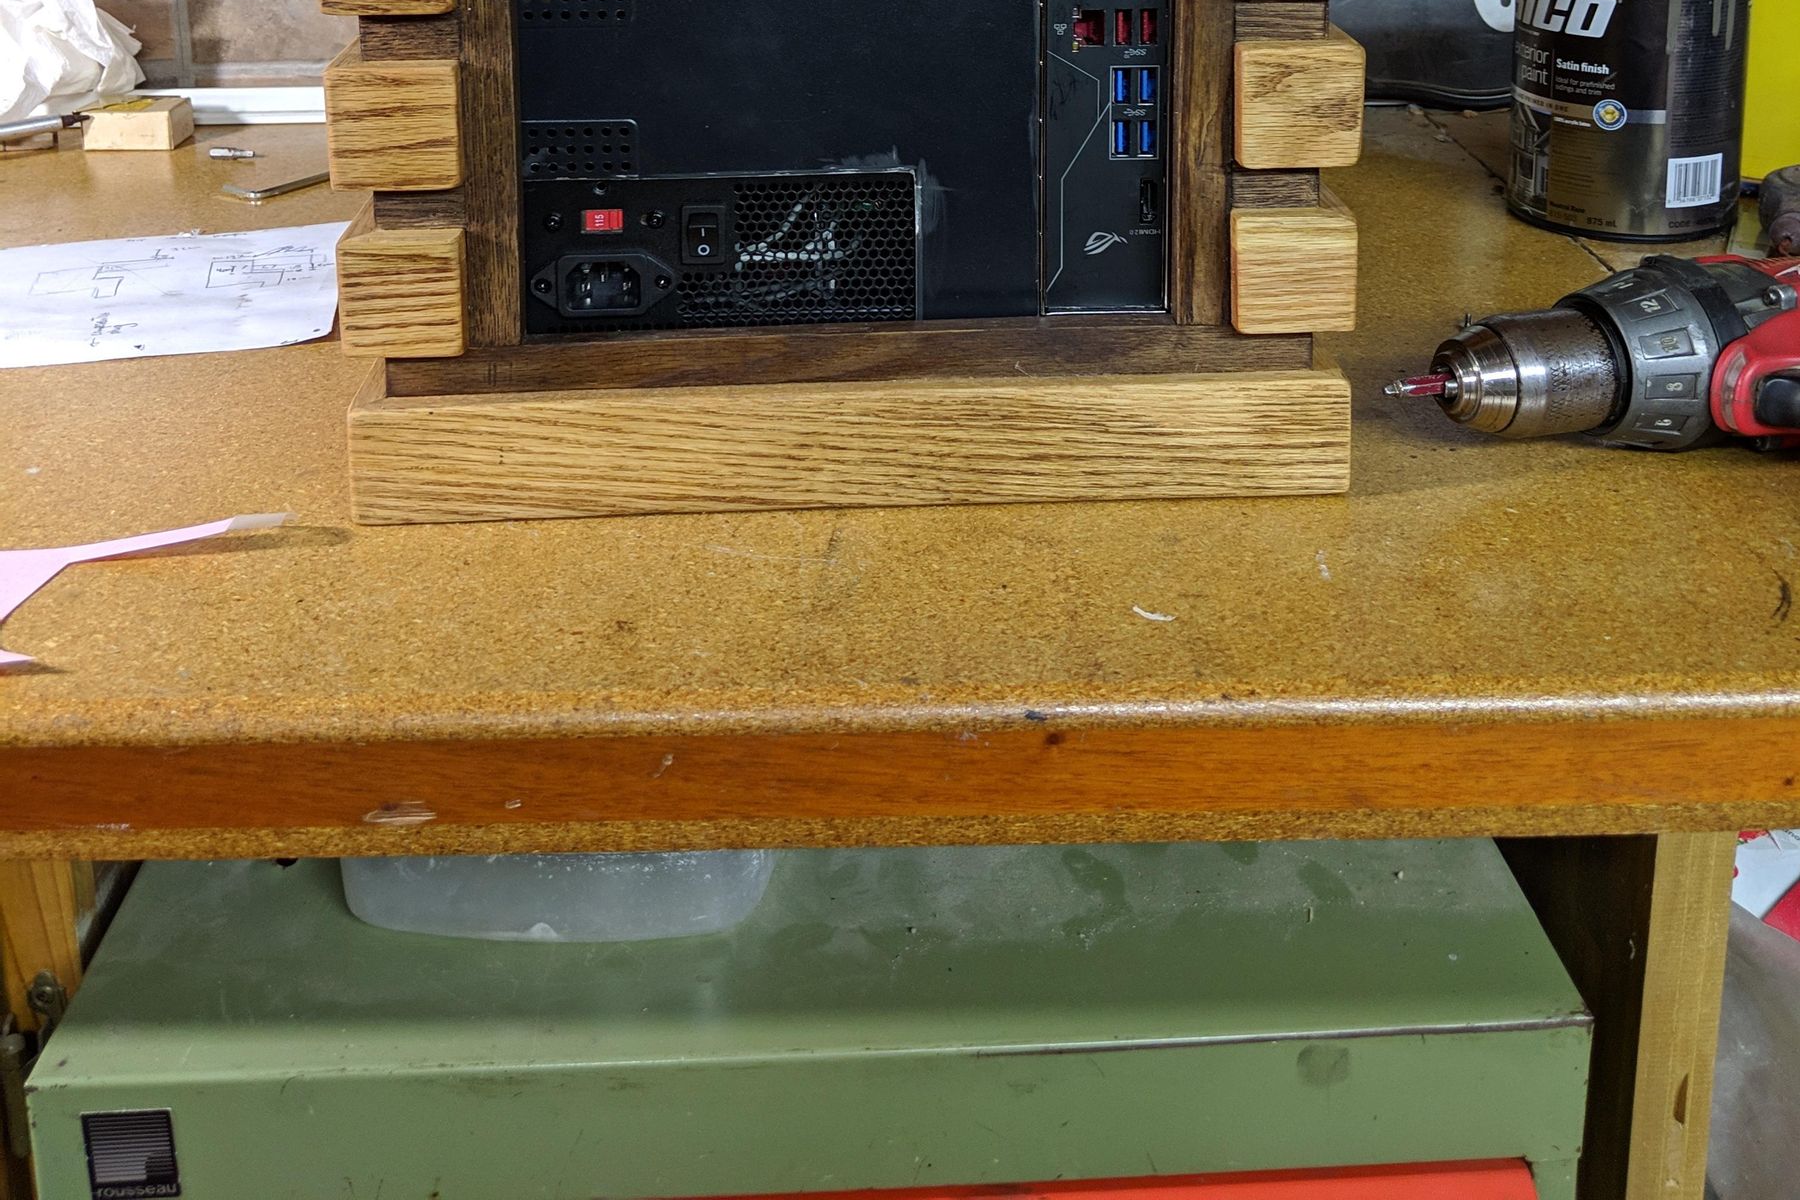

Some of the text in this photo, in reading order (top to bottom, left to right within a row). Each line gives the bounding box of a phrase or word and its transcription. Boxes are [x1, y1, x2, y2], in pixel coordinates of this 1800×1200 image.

[1556, 58, 1610, 75] Satin finish
[1519, 64, 1548, 86] paint
[594, 214, 605, 227] 115
[1639, 298, 1662, 313] 12
[1660, 335, 1681, 352] 10
[1666, 381, 1684, 392] 8
[96, 1183, 177, 1198] rousseau
